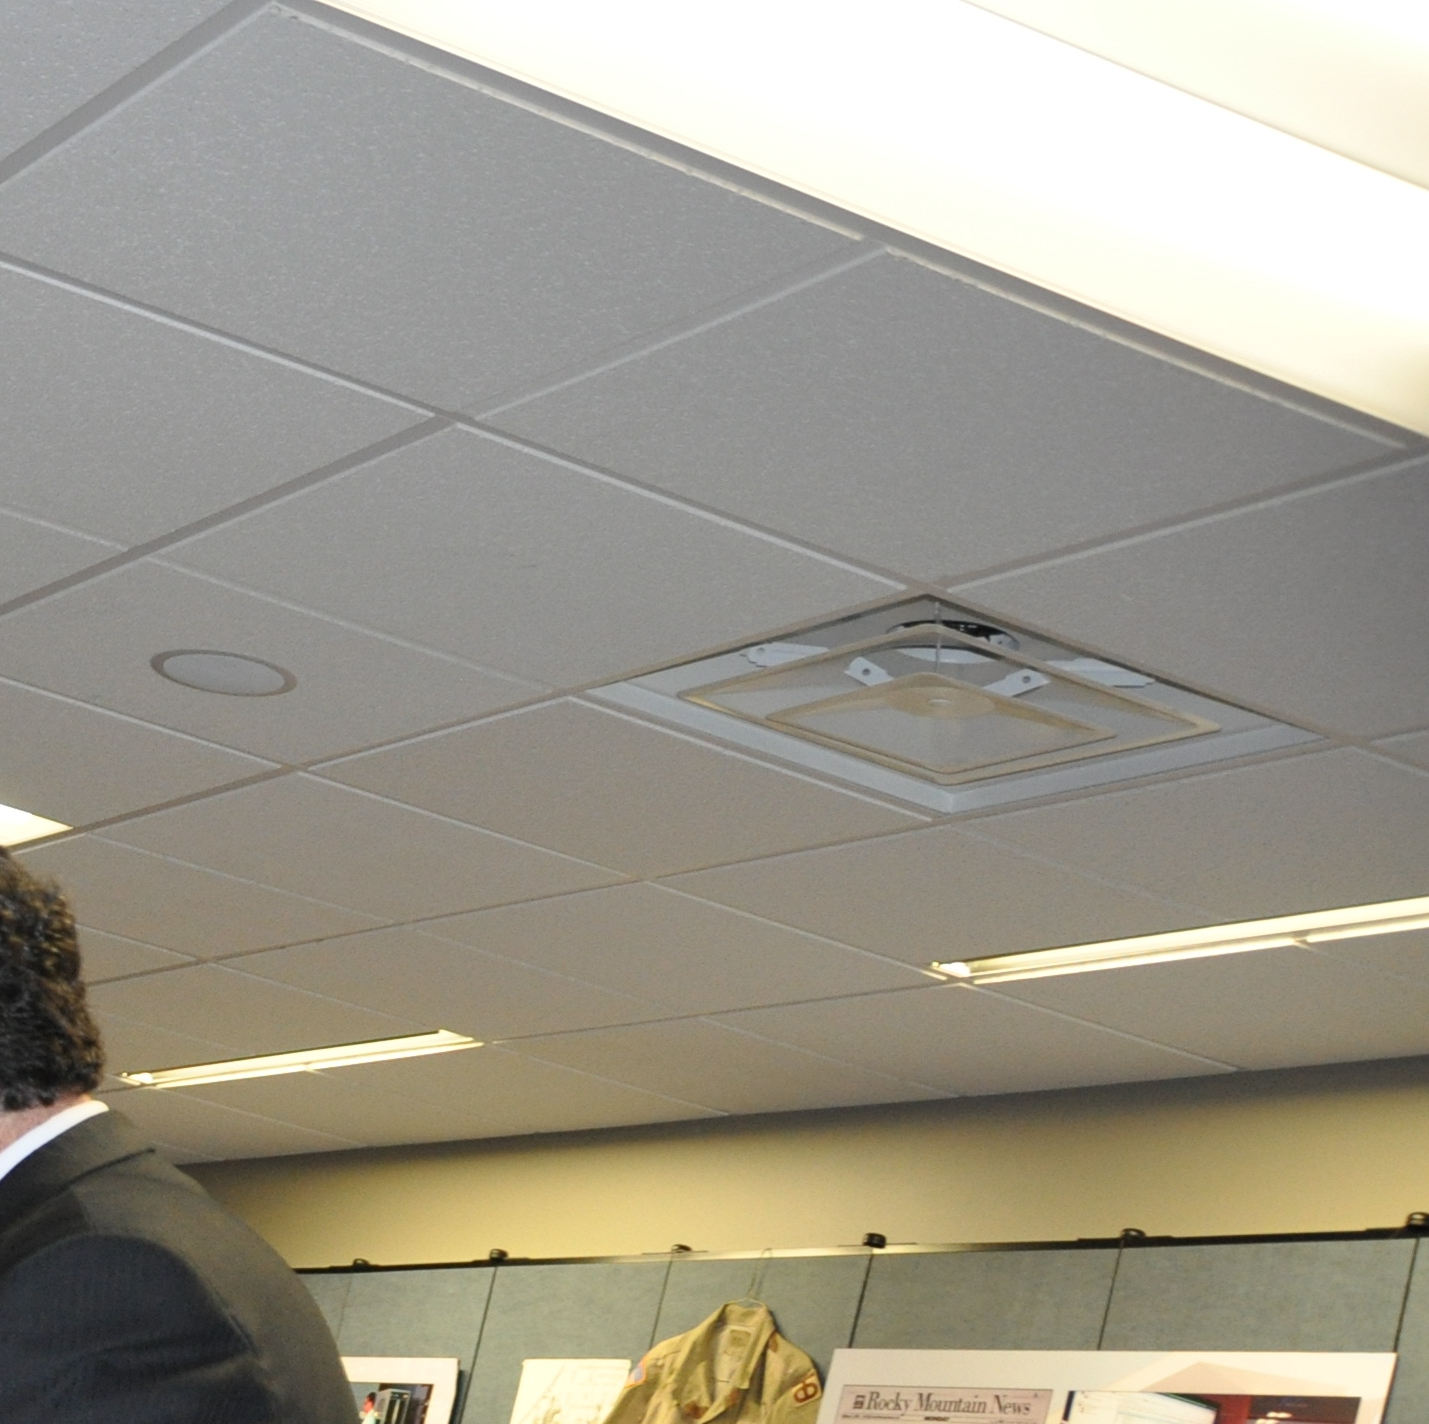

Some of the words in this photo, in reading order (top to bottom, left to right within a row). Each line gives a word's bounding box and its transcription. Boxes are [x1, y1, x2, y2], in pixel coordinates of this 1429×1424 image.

[866, 1391, 912, 1414] Rocky
[914, 1393, 987, 1414] Mountain
[991, 1395, 1031, 1415] News
